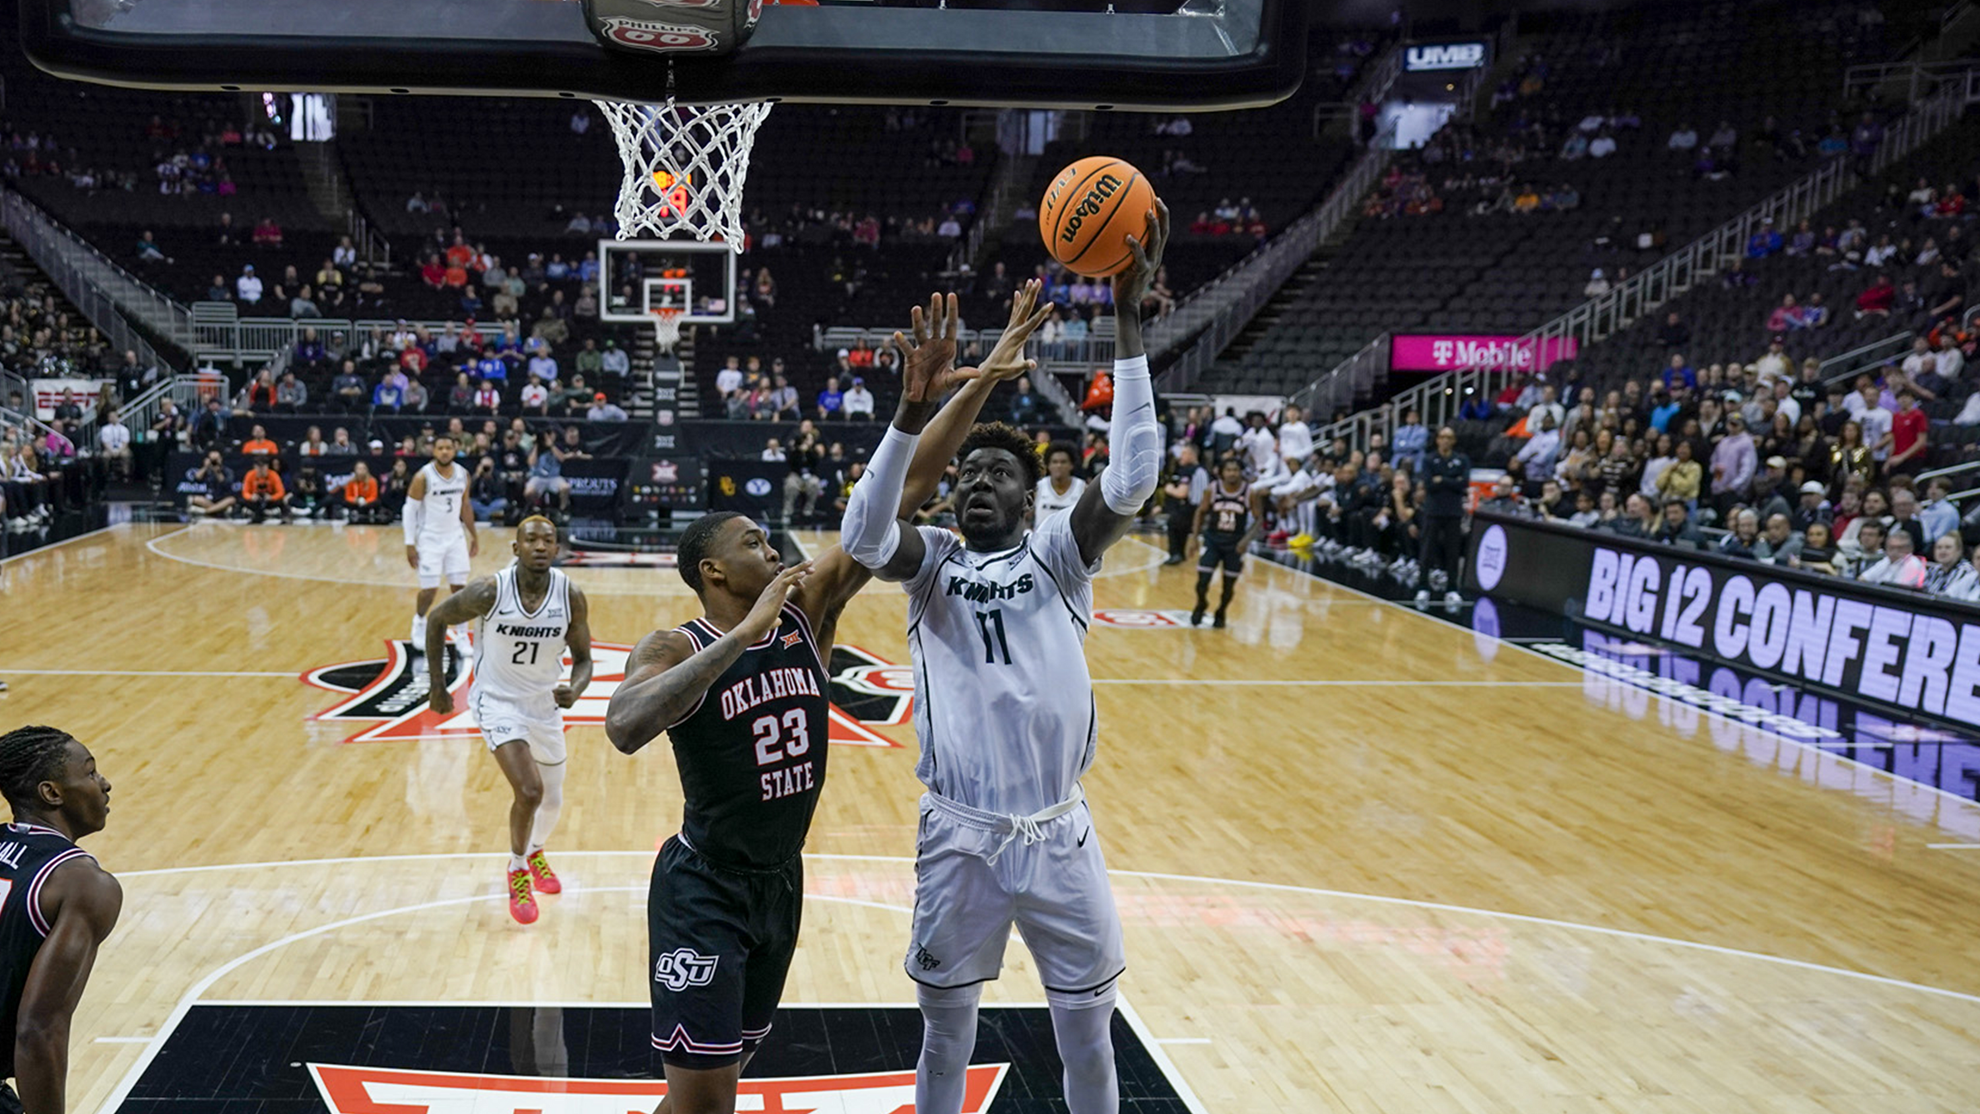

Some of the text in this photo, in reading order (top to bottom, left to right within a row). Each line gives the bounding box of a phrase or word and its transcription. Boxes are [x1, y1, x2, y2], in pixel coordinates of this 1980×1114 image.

[618, 19, 700, 34] PHILLIPS
[624, 30, 691, 45] 66
[1406, 43, 1484, 66] UMB
[1061, 174, 1124, 243] Wilson
[446, 496, 454, 514] 3
[496, 623, 562, 638] KNIGHTS
[976, 609, 1013, 666] 11
[1584, 547, 1661, 634] BIG
[1660, 564, 1713, 648] 12
[1713, 574, 1980, 728] CONFERE
[511, 641, 540, 665] 21
[720, 667, 822, 721] OKLAHOMA
[752, 707, 810, 767] 23
[760, 760, 815, 801] STATE
[655, 947, 720, 992] OSU
